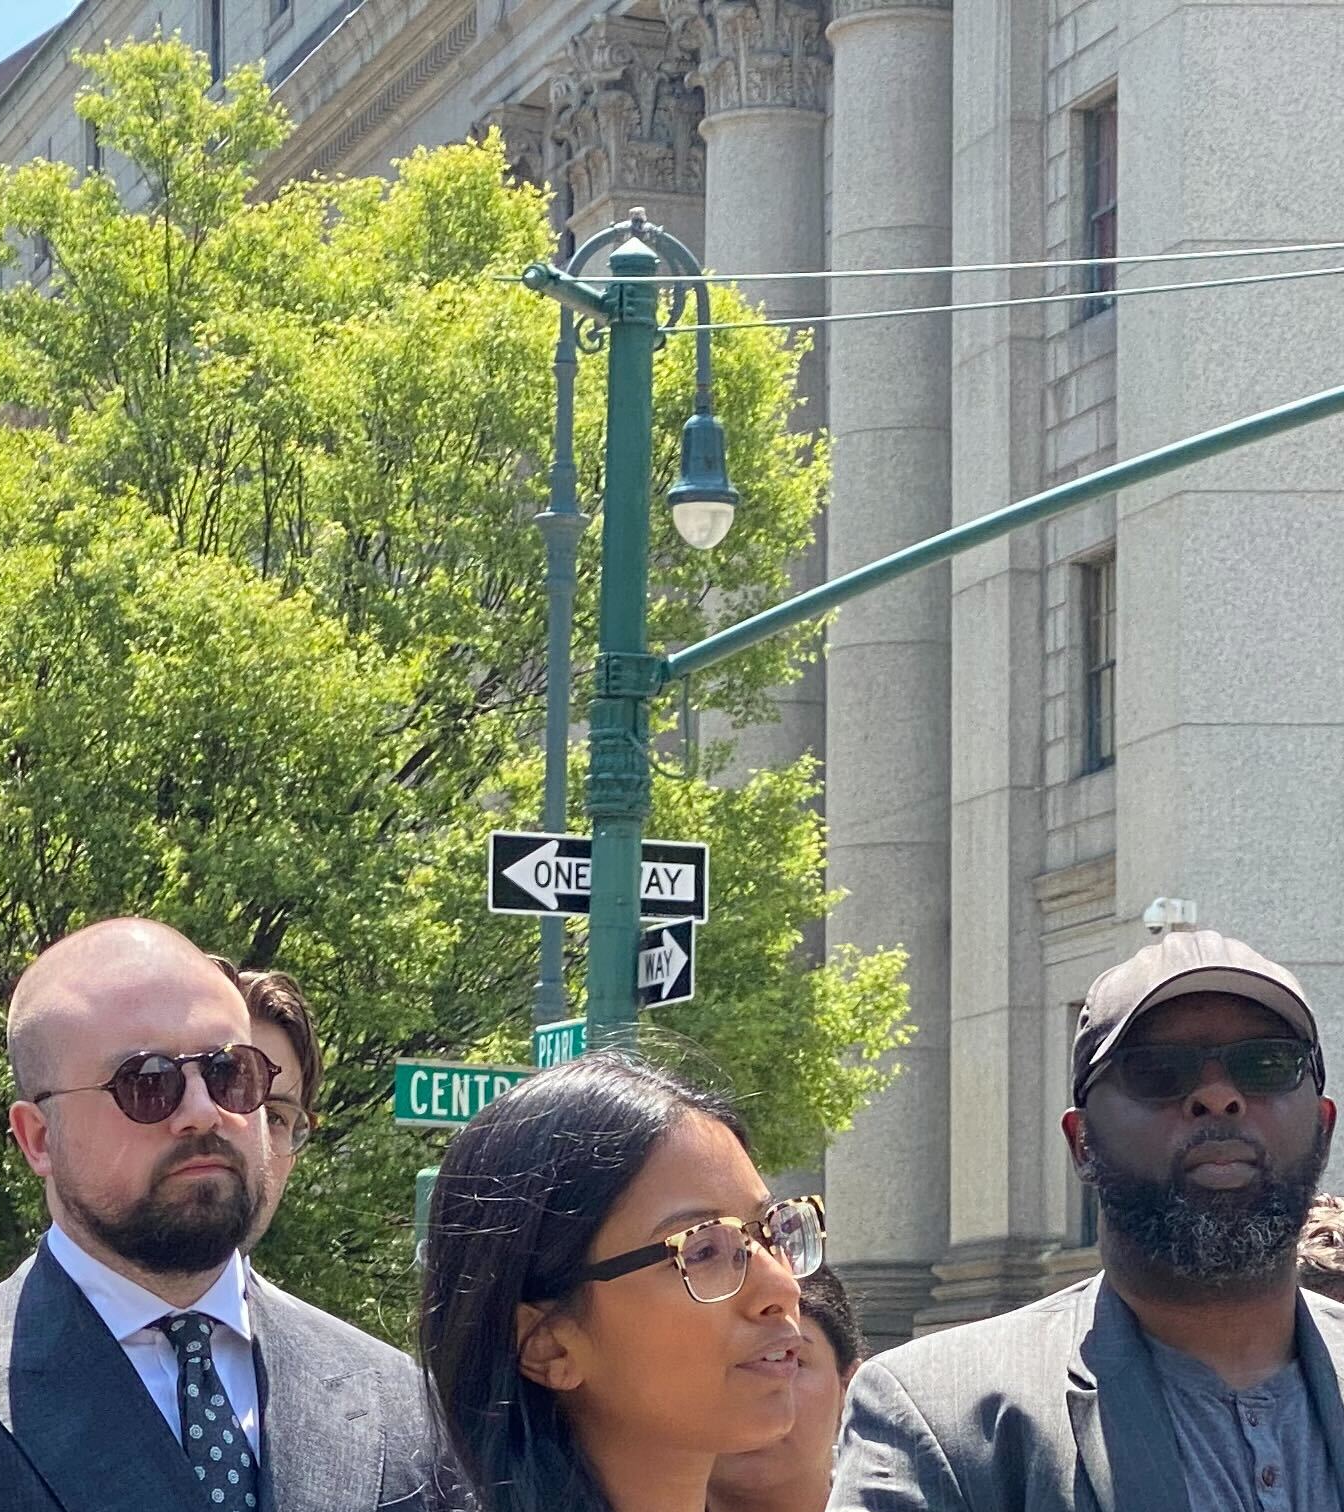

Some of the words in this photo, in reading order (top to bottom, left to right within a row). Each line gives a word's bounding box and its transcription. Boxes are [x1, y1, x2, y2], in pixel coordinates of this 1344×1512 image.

[534, 860, 591, 890] ONE
[641, 867, 683, 896] AY
[644, 949, 674, 981] WAY
[410, 1070, 524, 1118] CENT
